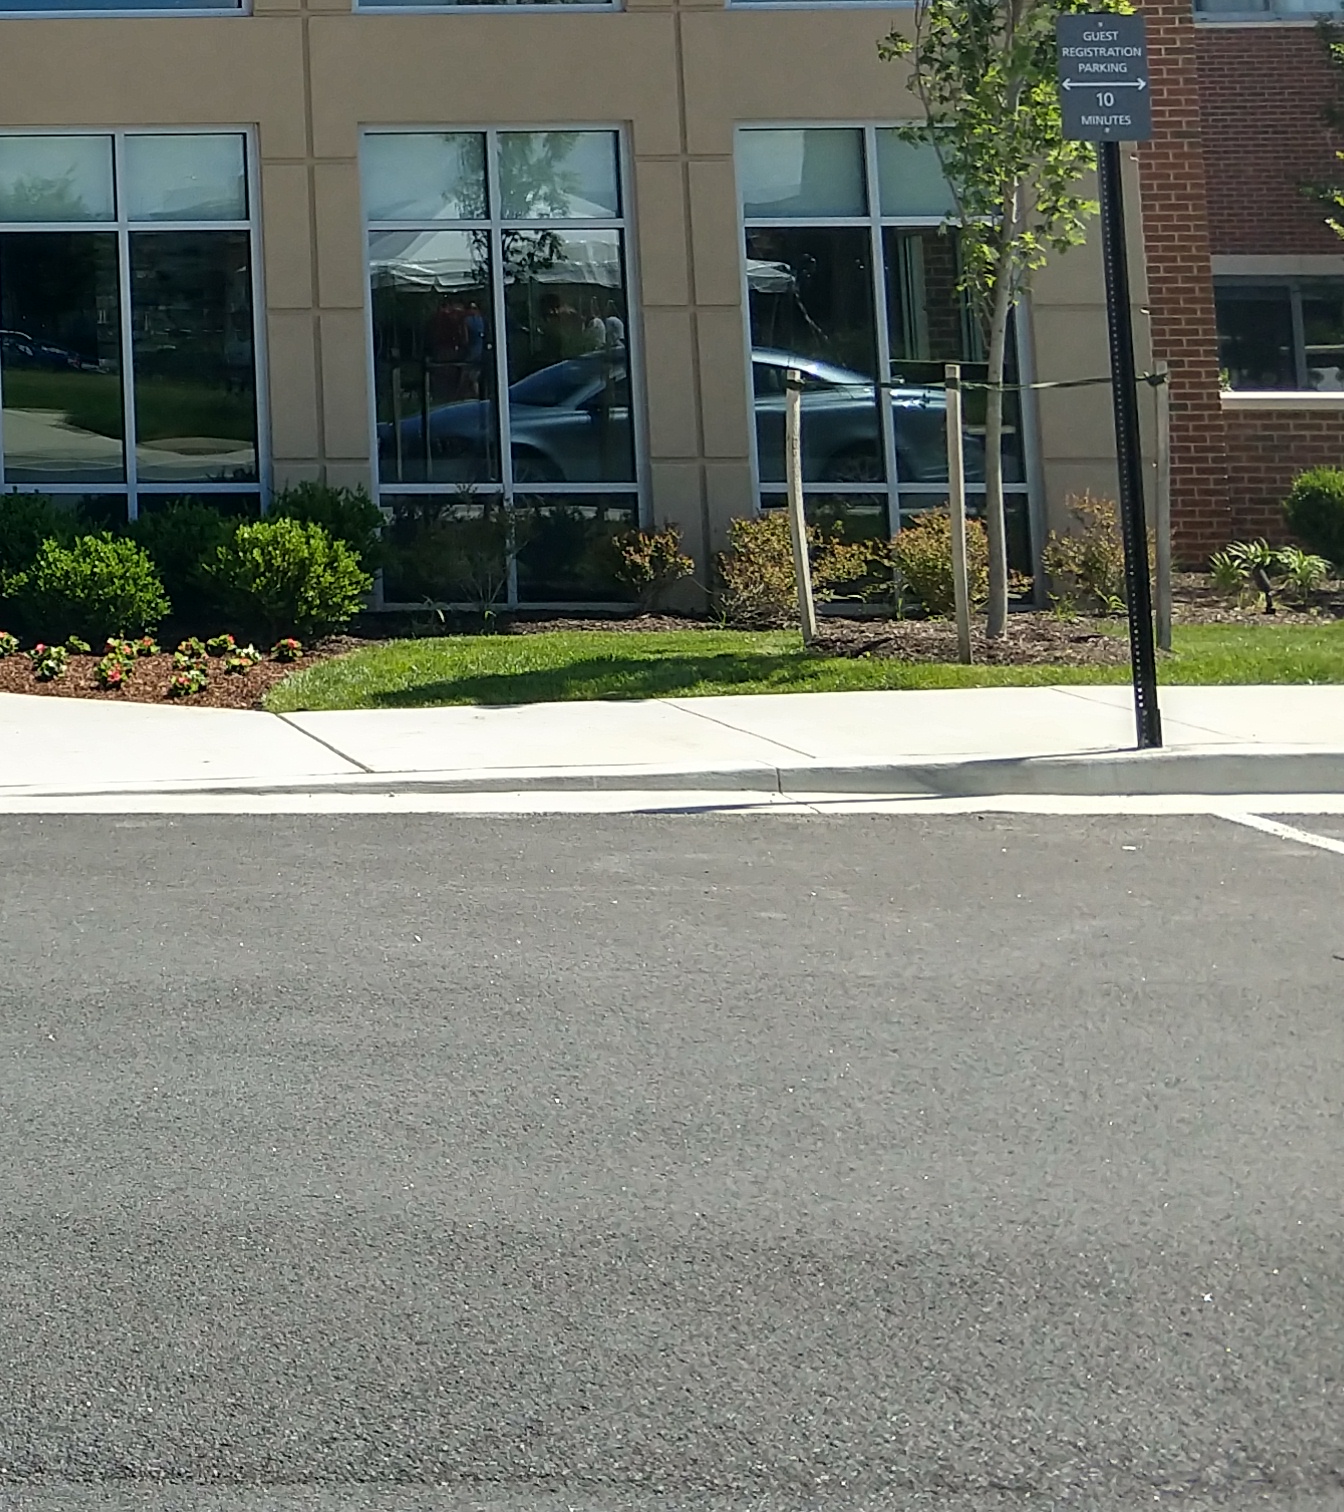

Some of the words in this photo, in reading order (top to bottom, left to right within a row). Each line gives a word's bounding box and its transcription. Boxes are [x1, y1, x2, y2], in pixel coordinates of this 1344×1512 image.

[1083, 31, 1119, 41] GUEST
[1062, 47, 1142, 57] REGISTRATION
[1078, 63, 1128, 73] PARKING
[1096, 92, 1114, 107] 10
[1081, 115, 1131, 125] MINUTES
